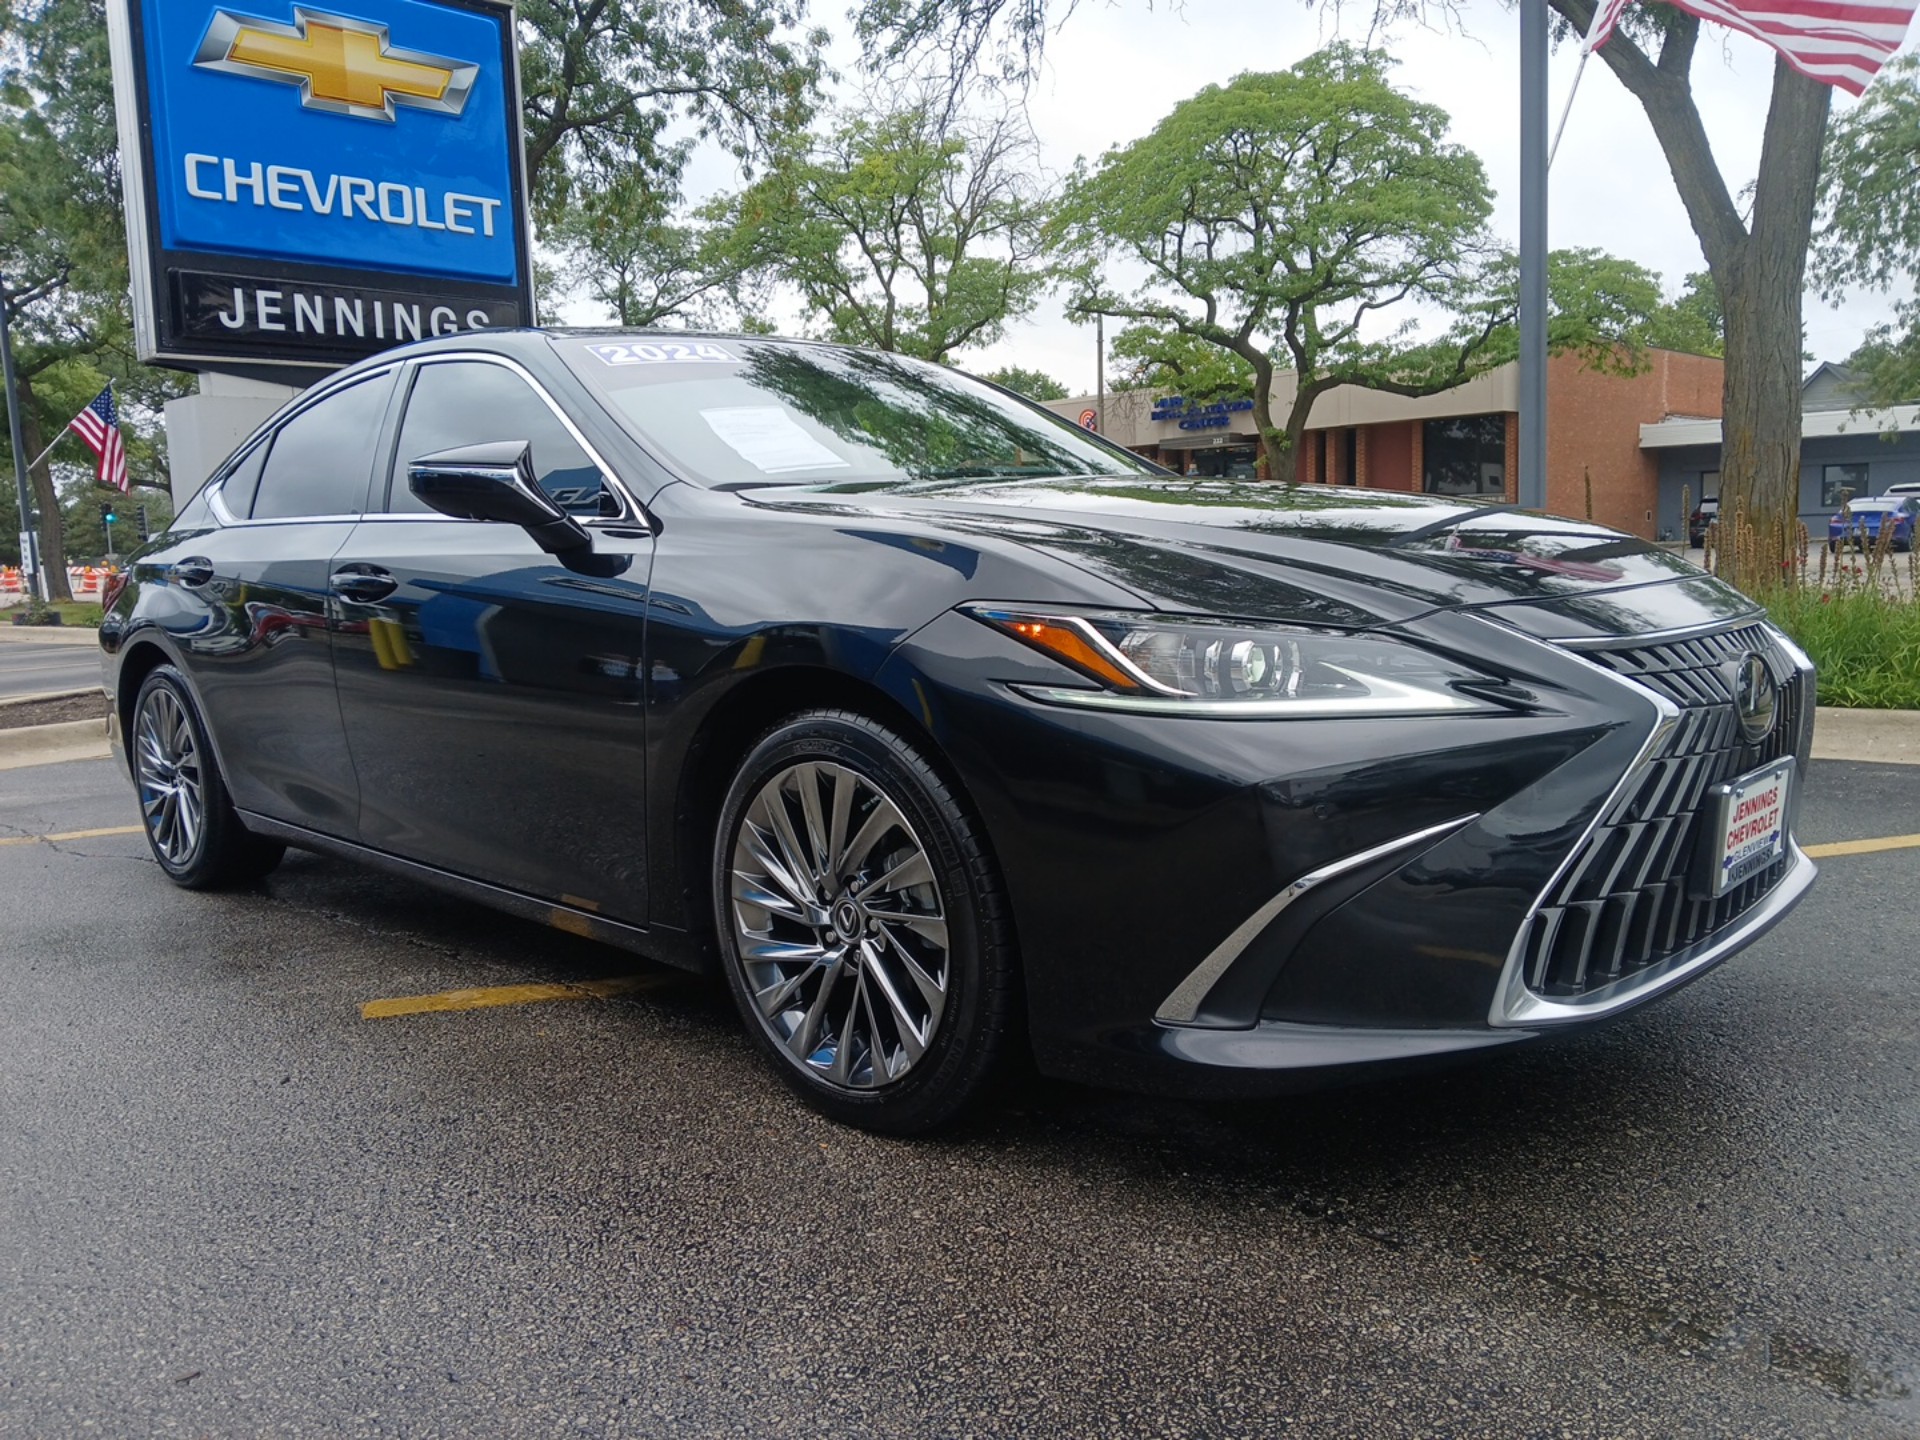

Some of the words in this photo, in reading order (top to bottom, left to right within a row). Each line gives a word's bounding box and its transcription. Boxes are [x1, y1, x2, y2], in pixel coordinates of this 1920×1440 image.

[185, 153, 501, 236] CHEVROLET
[600, 343, 727, 362] 2024
[1733, 787, 1778, 823] JENNINGS
[1727, 808, 1779, 850] CHEVROLET
